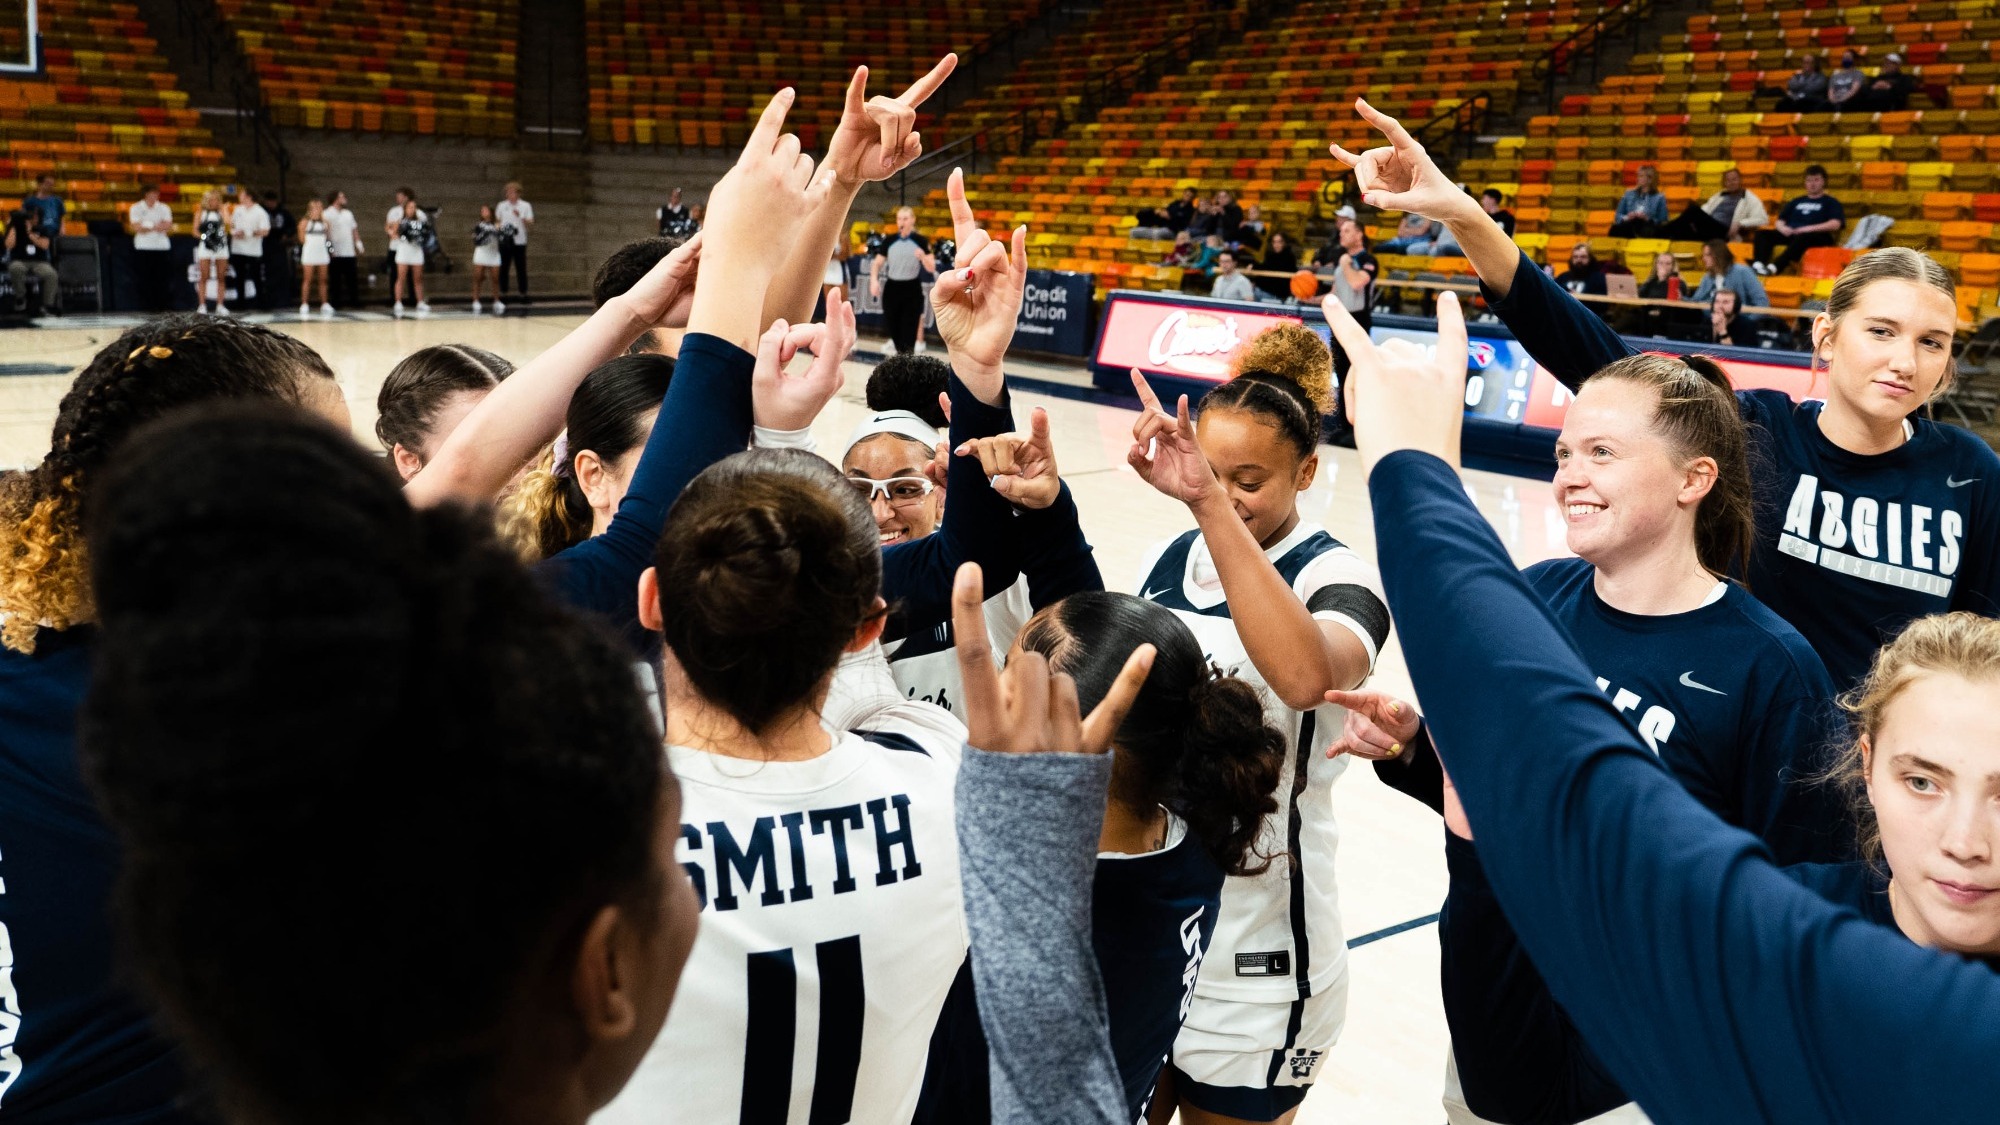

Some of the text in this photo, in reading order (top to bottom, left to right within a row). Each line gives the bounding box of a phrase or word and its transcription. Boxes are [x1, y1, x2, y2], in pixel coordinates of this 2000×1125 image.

[1025, 284, 1067, 303] Credit
[1024, 302, 1067, 321] Union
[680, 794, 922, 913] SMITH
[1274, 959, 1282, 969] L
[738, 934, 866, 1125] 11
